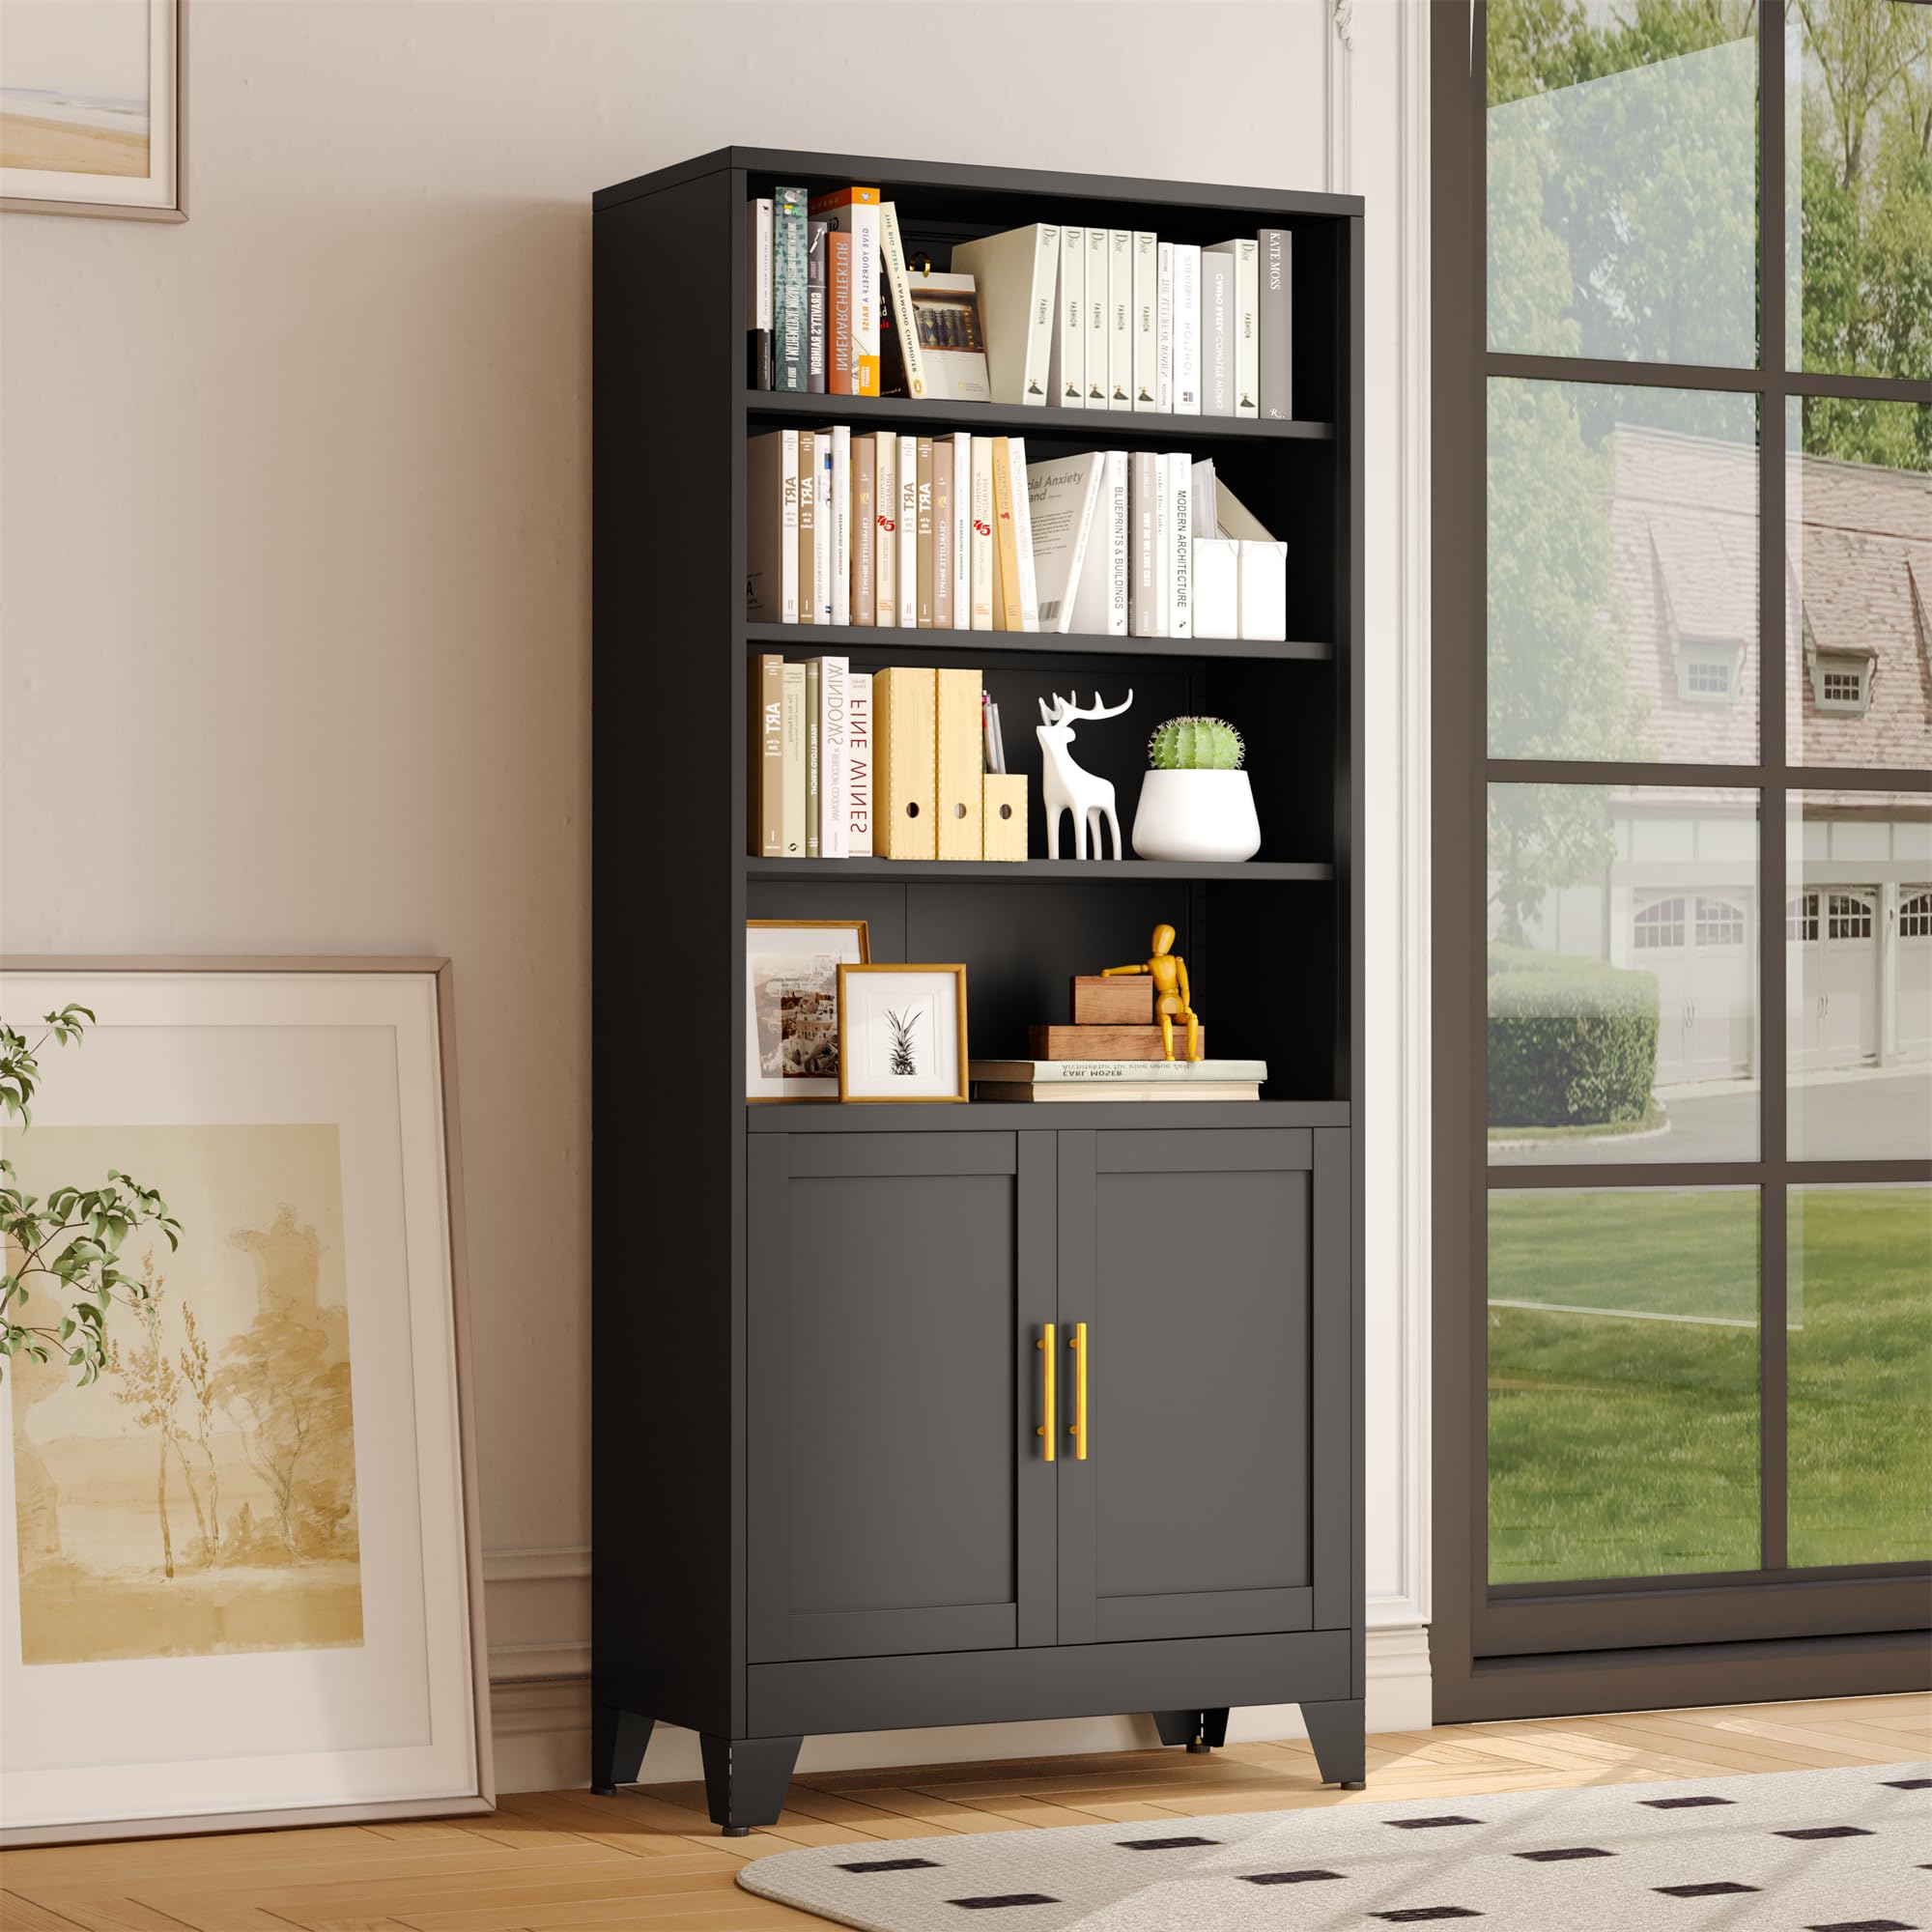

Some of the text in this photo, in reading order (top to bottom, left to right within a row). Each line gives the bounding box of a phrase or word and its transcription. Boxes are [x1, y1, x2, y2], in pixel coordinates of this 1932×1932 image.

[1043, 228, 1058, 247] Dior
[1067, 231, 1081, 249] Dior
[1091, 232, 1105, 251] Dior
[1115, 234, 1129, 253] Dior
[1140, 235, 1154, 254] Dior
[1243, 243, 1256, 262] Dior
[1269, 232, 1281, 291] KATE MOSS
[1039, 298, 1048, 326] FASHION
[1069, 300, 1078, 328] FASHION
[1094, 302, 1102, 329] FASHION
[1044, 471, 1084, 487] Anxiety
[1114, 486, 1123, 547] BLUEPRINTS
[1177, 490, 1187, 532] MODERN
[1115, 558, 1123, 610] BUILDINGS
[1177, 534, 1187, 608] ARCHITECTURE
